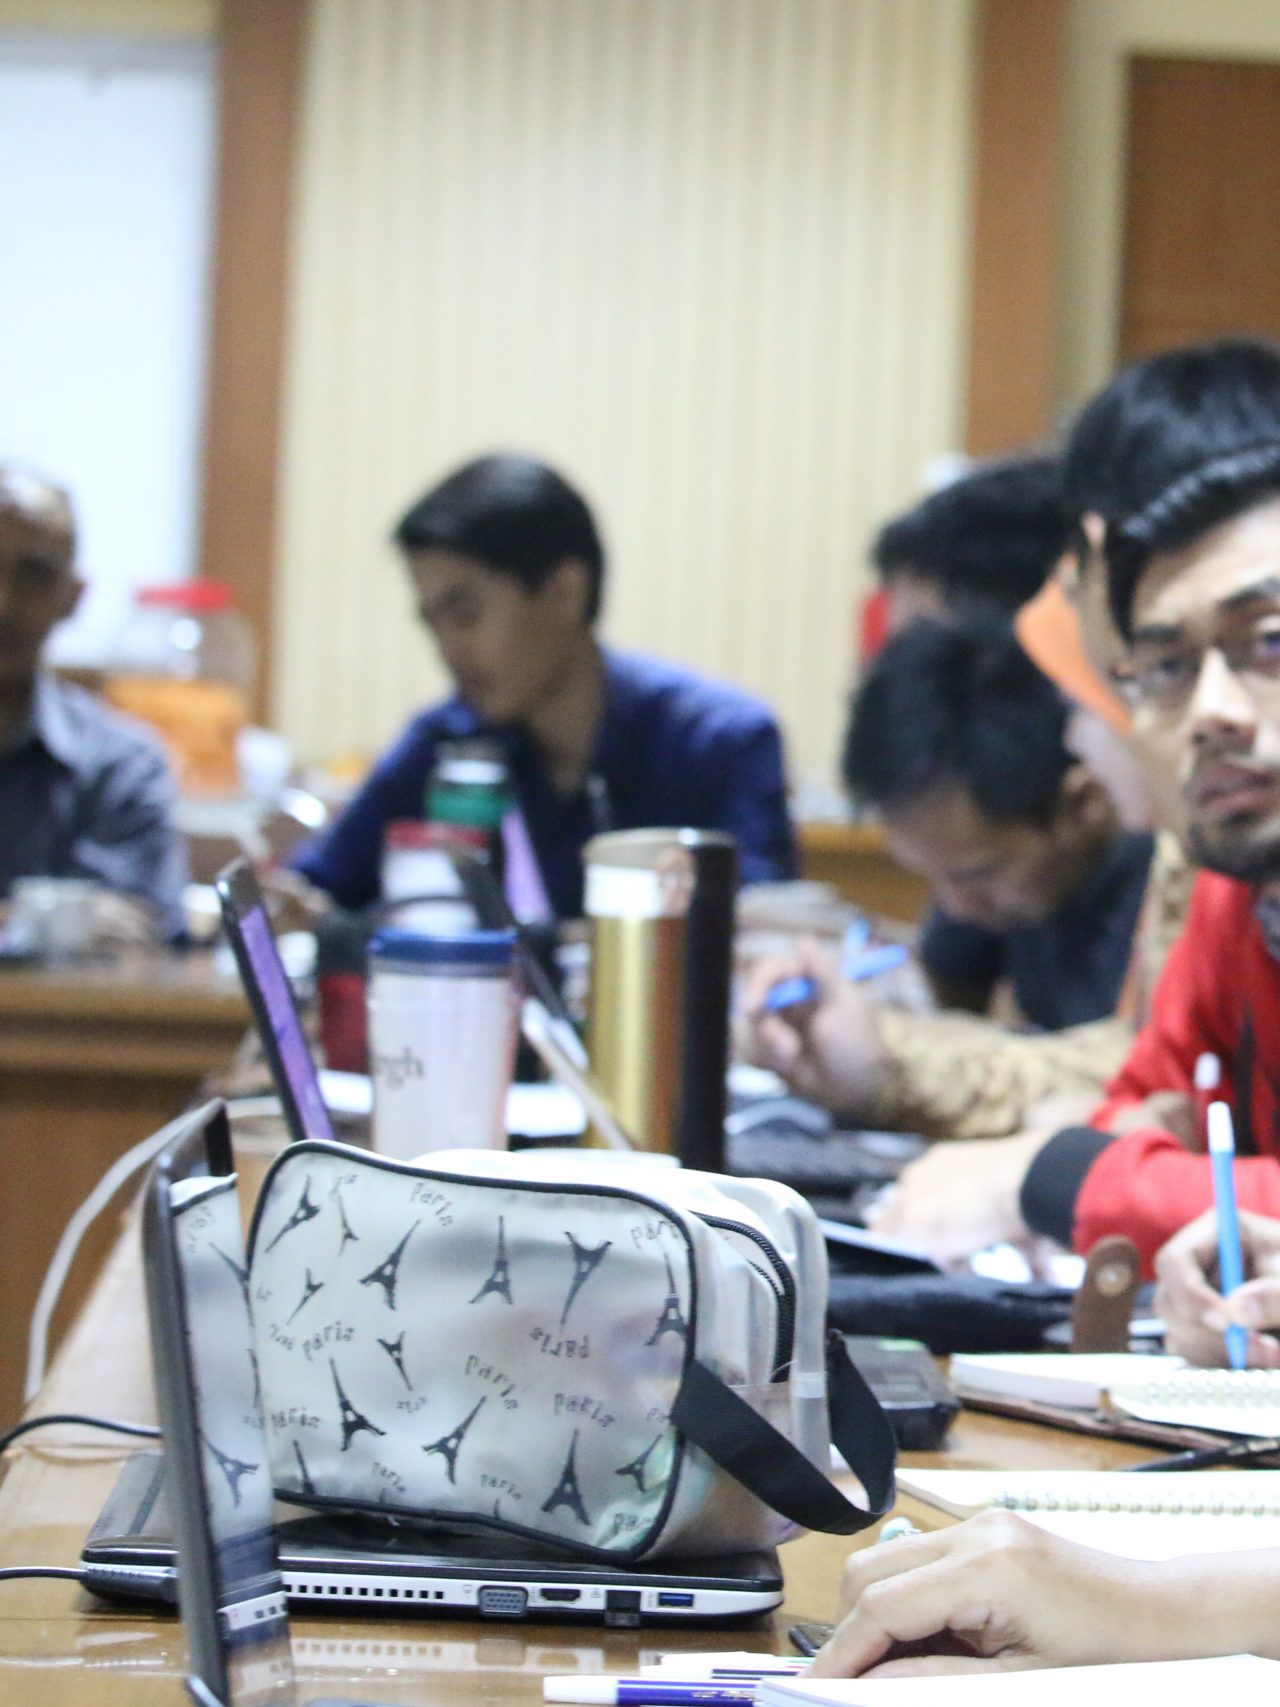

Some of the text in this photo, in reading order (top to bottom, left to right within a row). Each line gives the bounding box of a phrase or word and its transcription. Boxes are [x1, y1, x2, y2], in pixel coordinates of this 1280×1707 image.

[302, 1320, 354, 1361] paris
[465, 1354, 519, 1410] paris
[553, 1393, 614, 1428] paris
